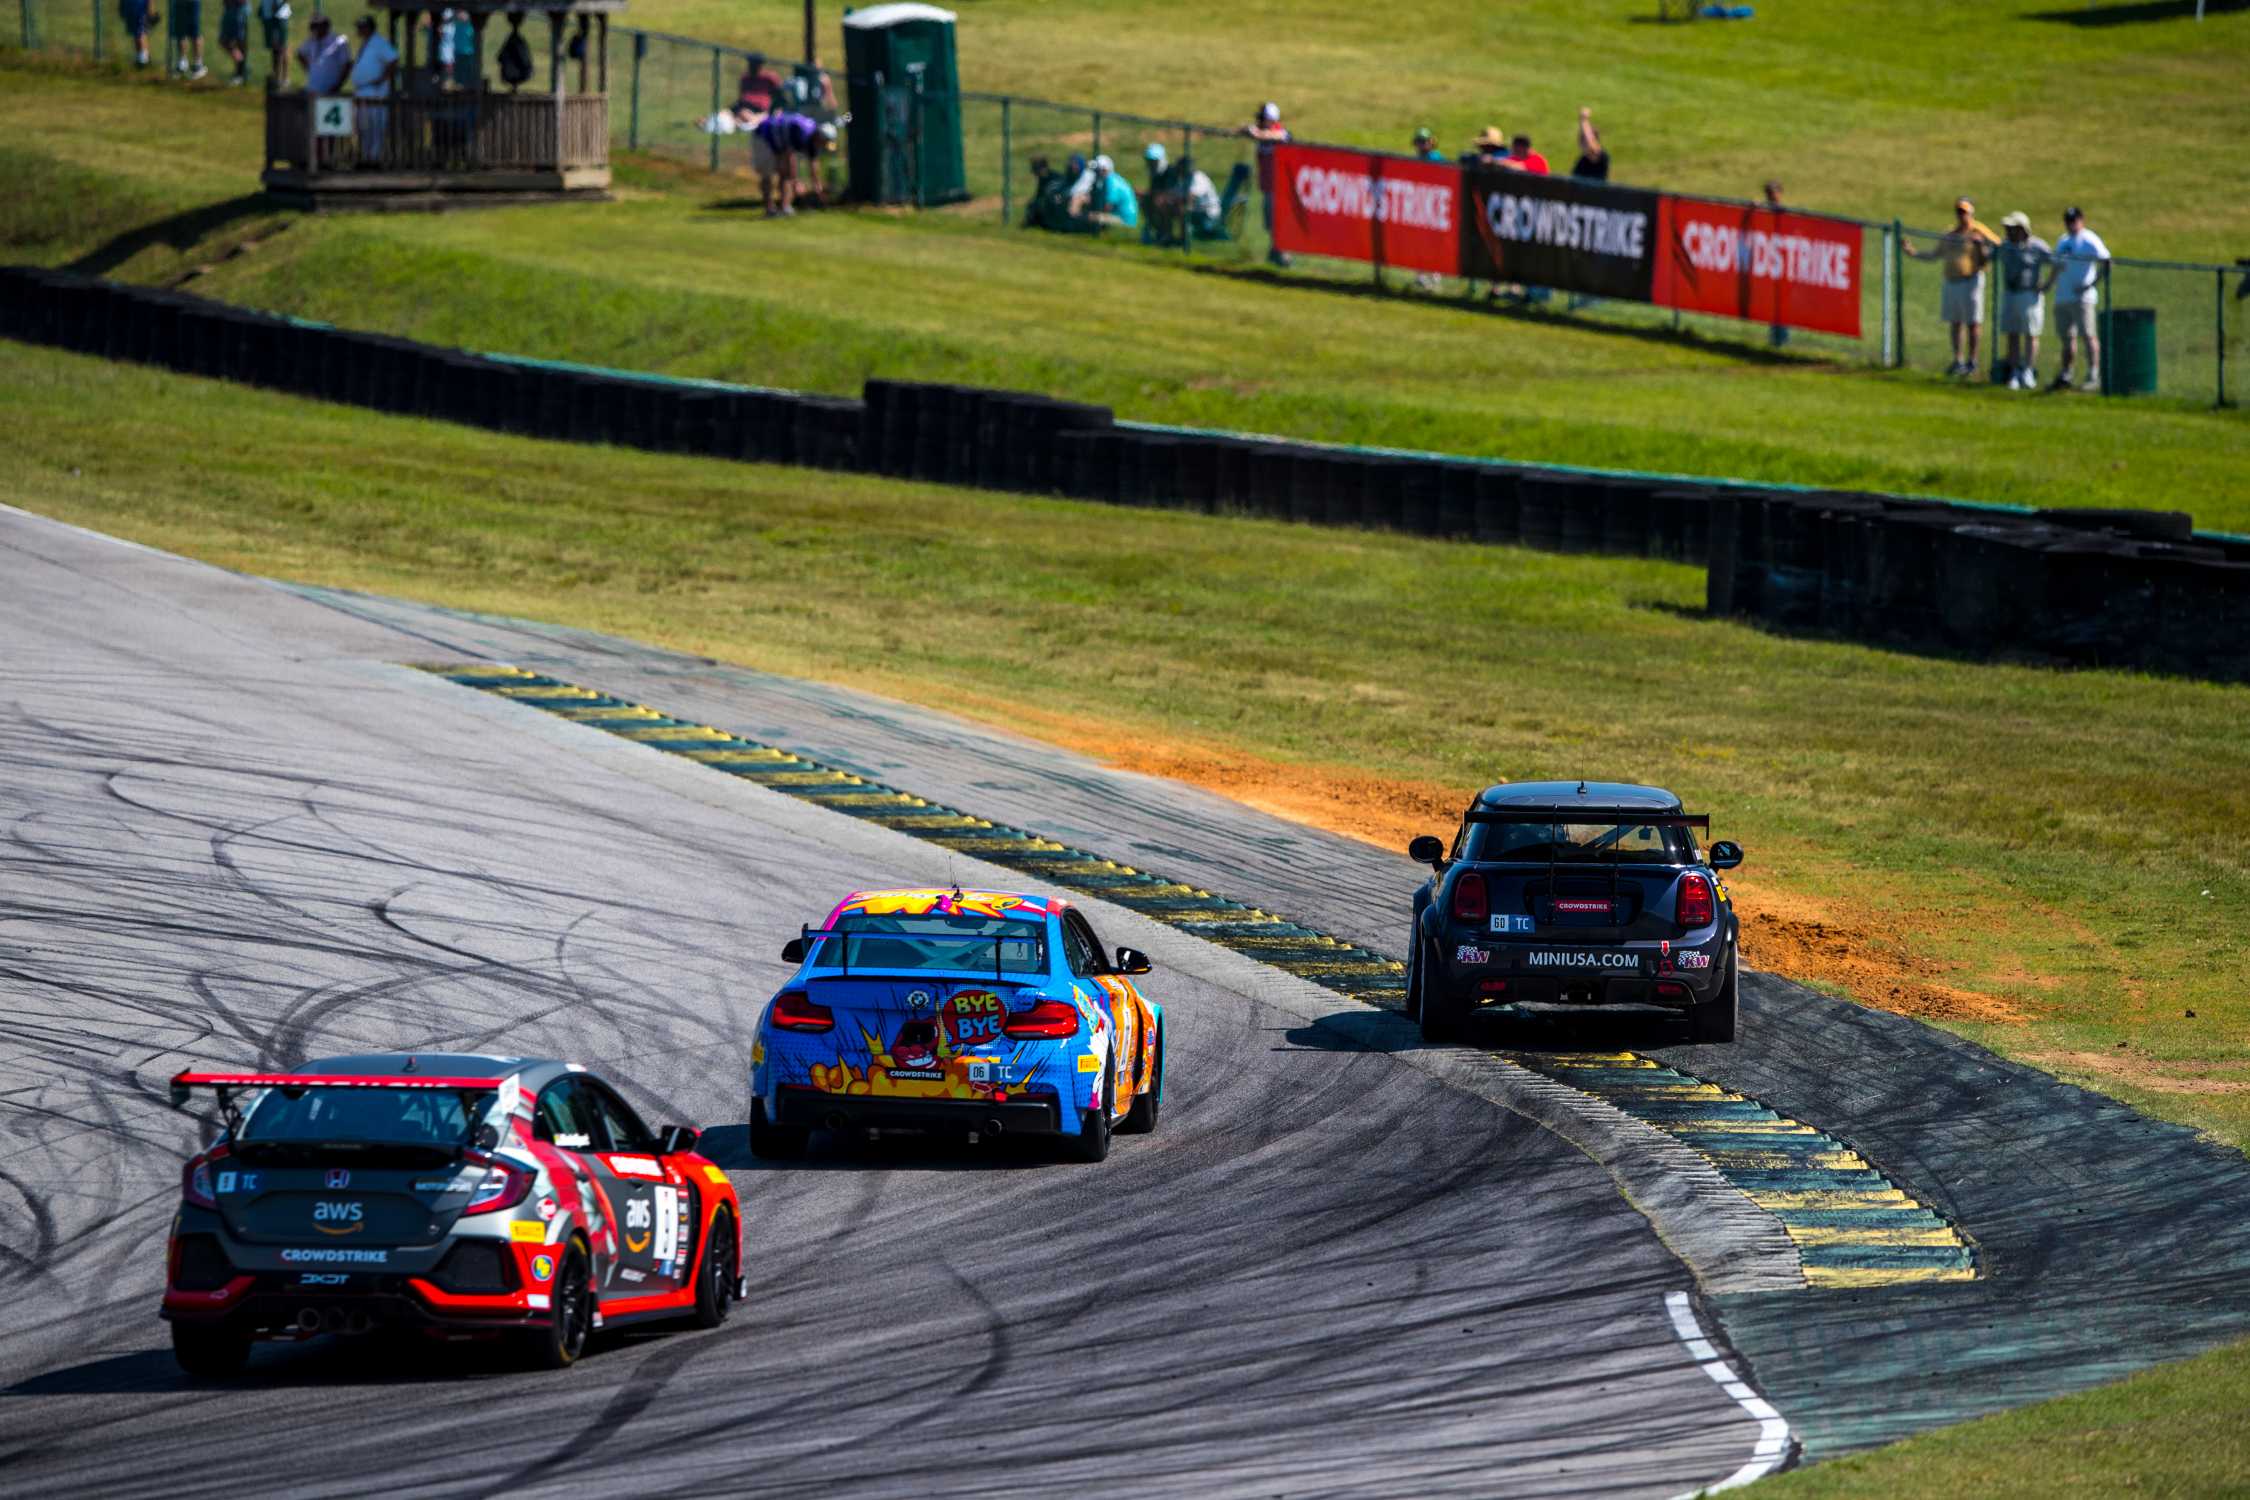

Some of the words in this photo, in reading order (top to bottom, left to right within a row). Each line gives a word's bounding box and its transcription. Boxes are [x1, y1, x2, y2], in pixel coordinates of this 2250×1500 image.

[324, 105, 342, 126] 4
[1296, 165, 1452, 232] CROWDSTRIKE
[1487, 191, 1647, 259] CROWDSTRIKE
[1682, 220, 1850, 289] CROWDSTRIKE
[1558, 902, 1608, 911] CROWDSTRIKE
[1494, 916, 1505, 929] 60
[1515, 917, 1529, 930] TC
[1529, 951, 1639, 967] MINIUSA.COM
[953, 992, 999, 1014] BYE
[957, 1014, 1002, 1039] BYE
[889, 1069, 943, 1080] CROWDSTRIKE
[972, 1065, 985, 1079] 06
[997, 1065, 1013, 1080] TC
[242, 1173, 257, 1190] TC
[313, 1201, 364, 1221] aws
[626, 1198, 651, 1229] aws
[281, 1248, 387, 1263] CROWDSTRIKE
